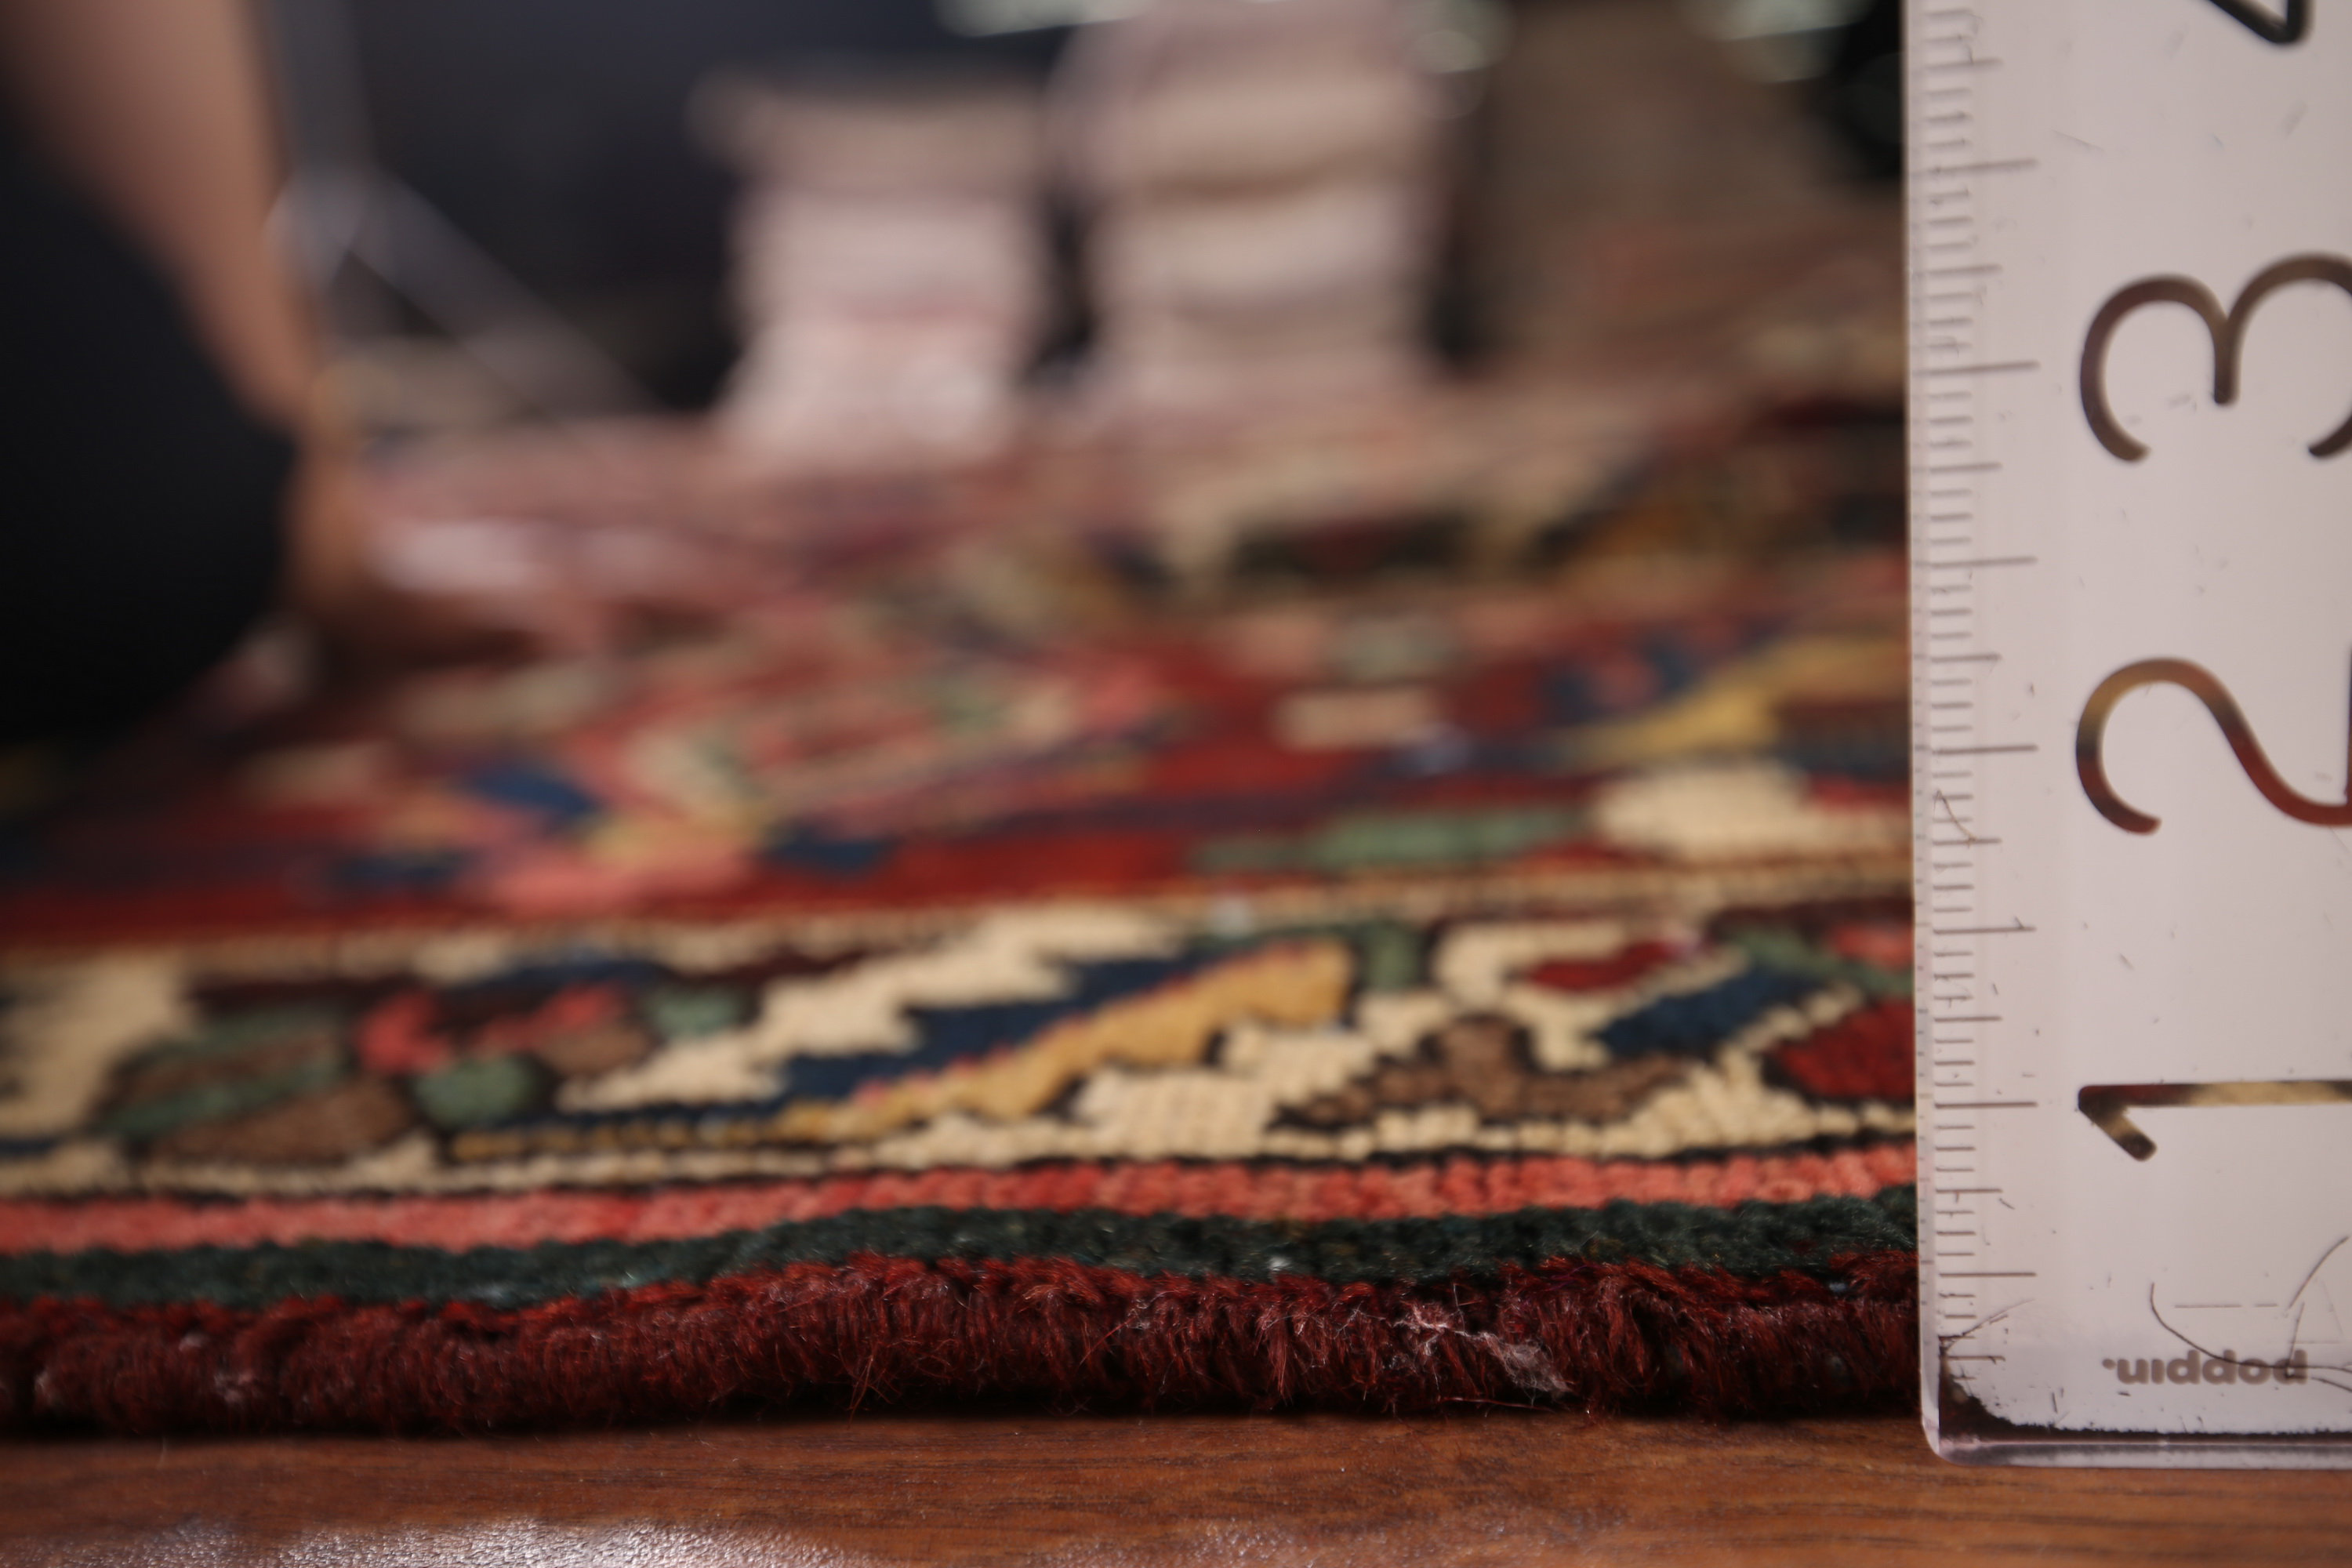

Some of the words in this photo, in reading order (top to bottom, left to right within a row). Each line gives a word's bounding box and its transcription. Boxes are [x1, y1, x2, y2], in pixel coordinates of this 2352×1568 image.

[2079, 252, 2352, 462] 3
[2076, 649, 2352, 835] 2
[2078, 1080, 2352, 1161] 1
